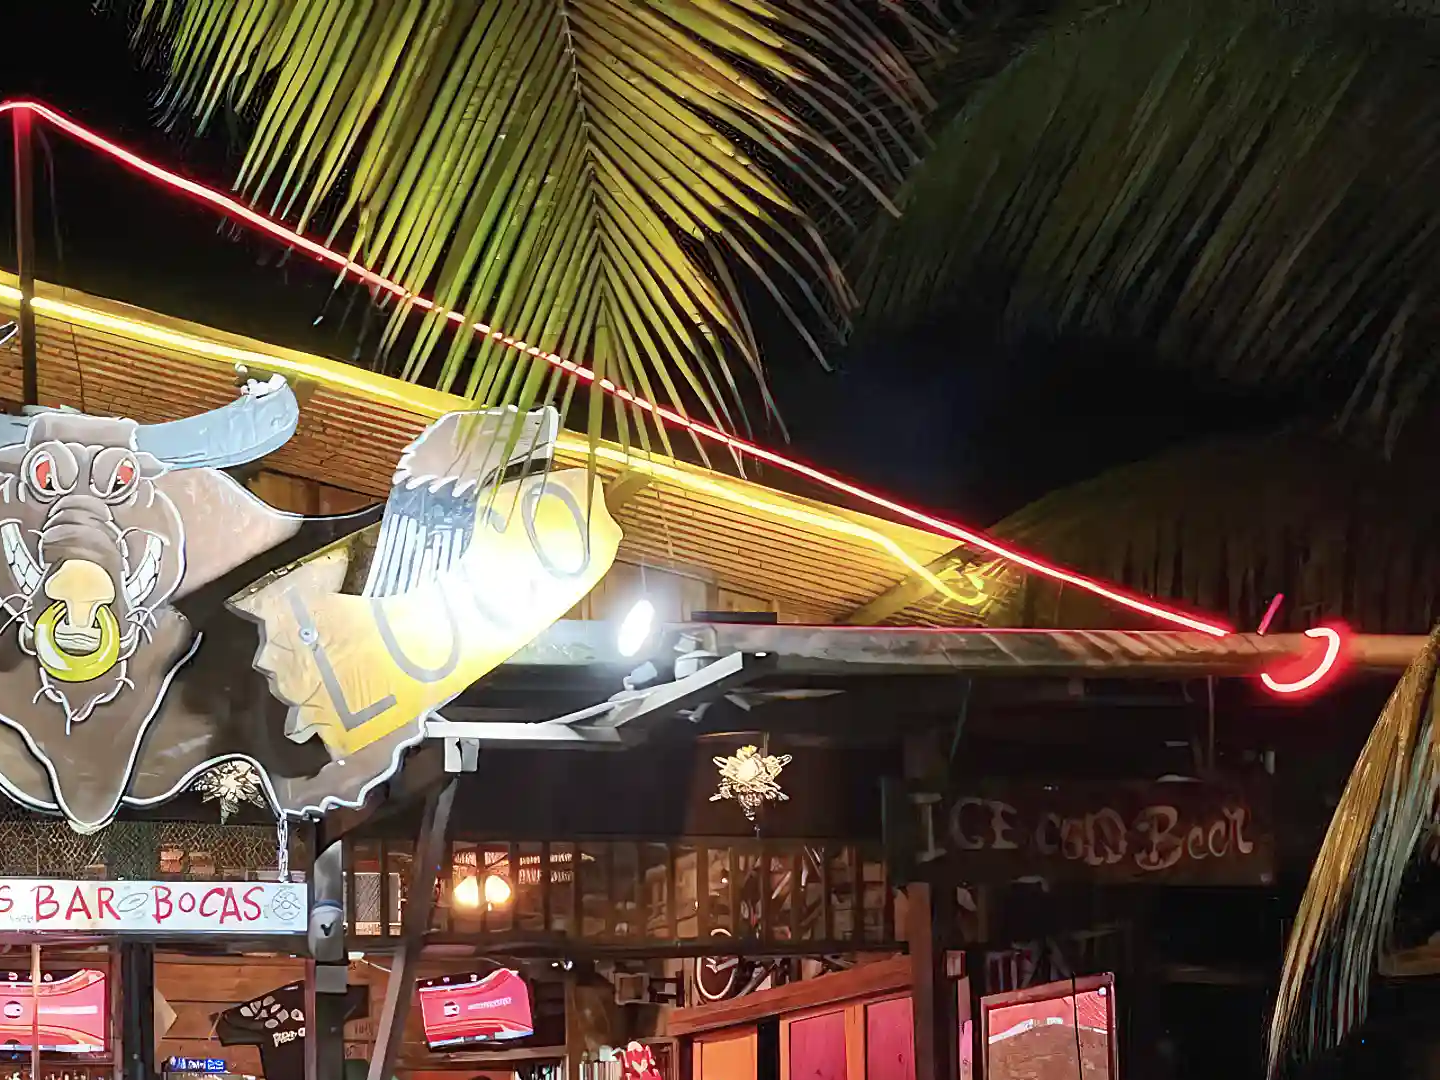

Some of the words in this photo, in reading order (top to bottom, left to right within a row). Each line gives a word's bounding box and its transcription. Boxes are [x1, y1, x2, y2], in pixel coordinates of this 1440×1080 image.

[907, 791, 1019, 864] ICE
[30, 884, 122, 922] BAR
[150, 885, 265, 924] BOCAS
